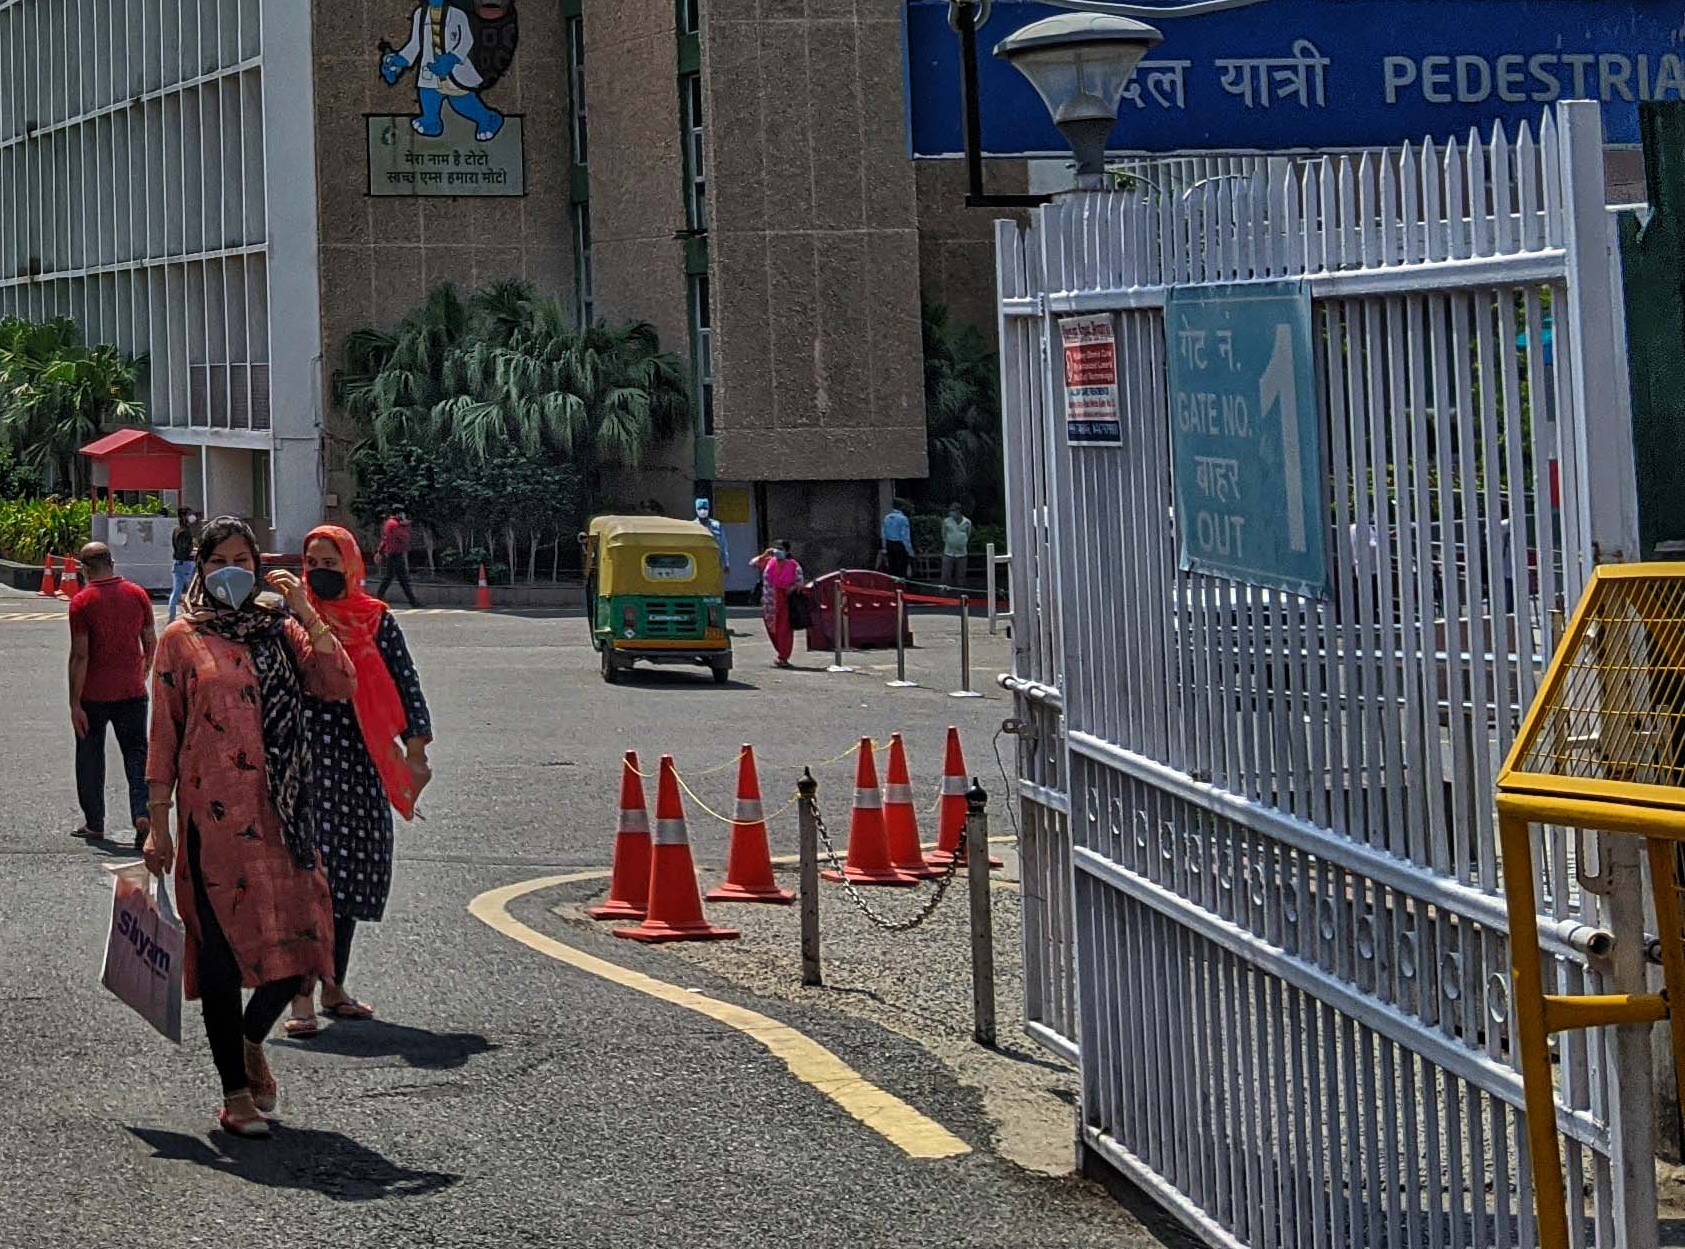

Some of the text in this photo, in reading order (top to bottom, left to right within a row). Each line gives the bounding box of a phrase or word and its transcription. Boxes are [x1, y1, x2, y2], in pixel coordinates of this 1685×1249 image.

[1216, 39, 1330, 108] यात्री
[405, 150, 424, 166] मेरा
[427, 154, 449, 166] नाम
[465, 150, 488, 166] टोटो
[420, 171, 442, 185] एम्स
[448, 171, 478, 184] हमारा
[1178, 313, 1209, 370] गेट
[1178, 391, 1253, 437] GATE NO.
[1259, 323, 1307, 552] 1
[1194, 455, 1241, 503] बाहर
[1197, 510, 1245, 558] OUT
[118, 909, 170, 973] Shyam
